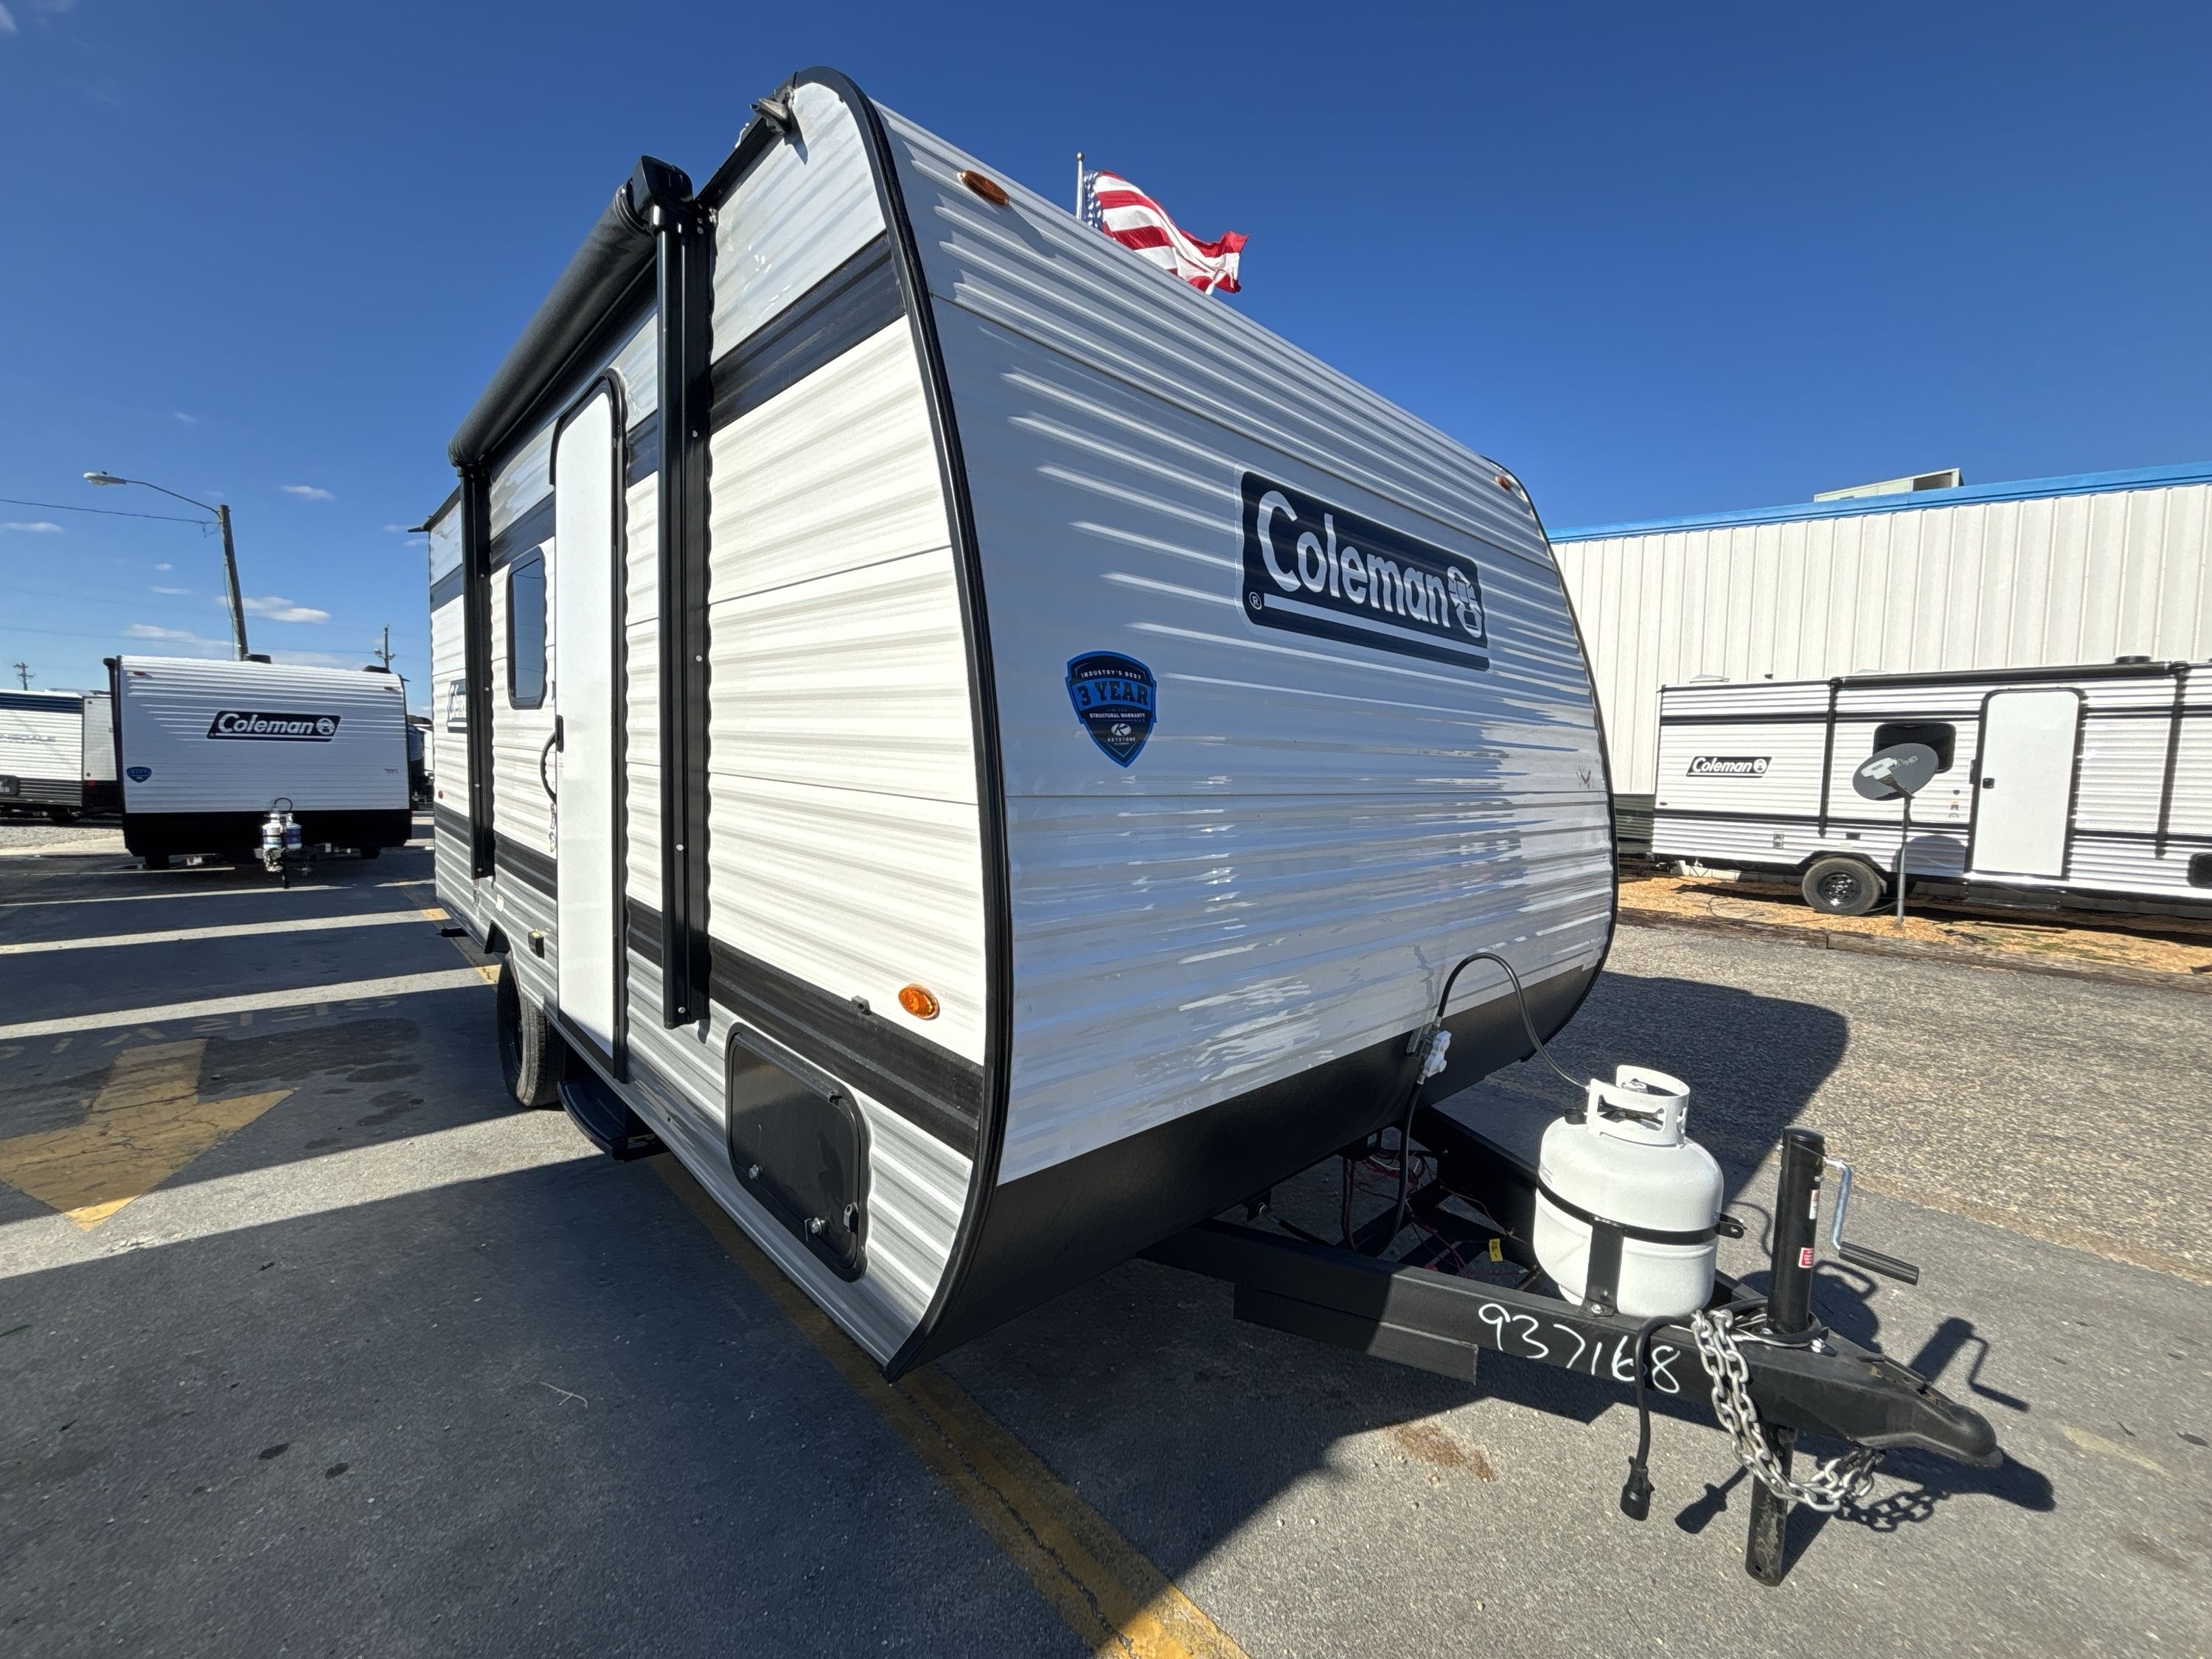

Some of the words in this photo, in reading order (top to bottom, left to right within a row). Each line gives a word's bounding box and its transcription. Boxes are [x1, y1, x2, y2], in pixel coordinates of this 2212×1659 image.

[1257, 490, 1450, 627] Coleman
[1081, 669, 1122, 678] INDUSTRY'S
[1124, 671, 1141, 680] BEST
[1077, 685, 1091, 706] 3
[1094, 681, 1148, 706] YEAR
[218, 713, 314, 734] Coleman
[1693, 757, 1753, 773] Coleman
[1478, 1303, 1680, 1394] 937168
